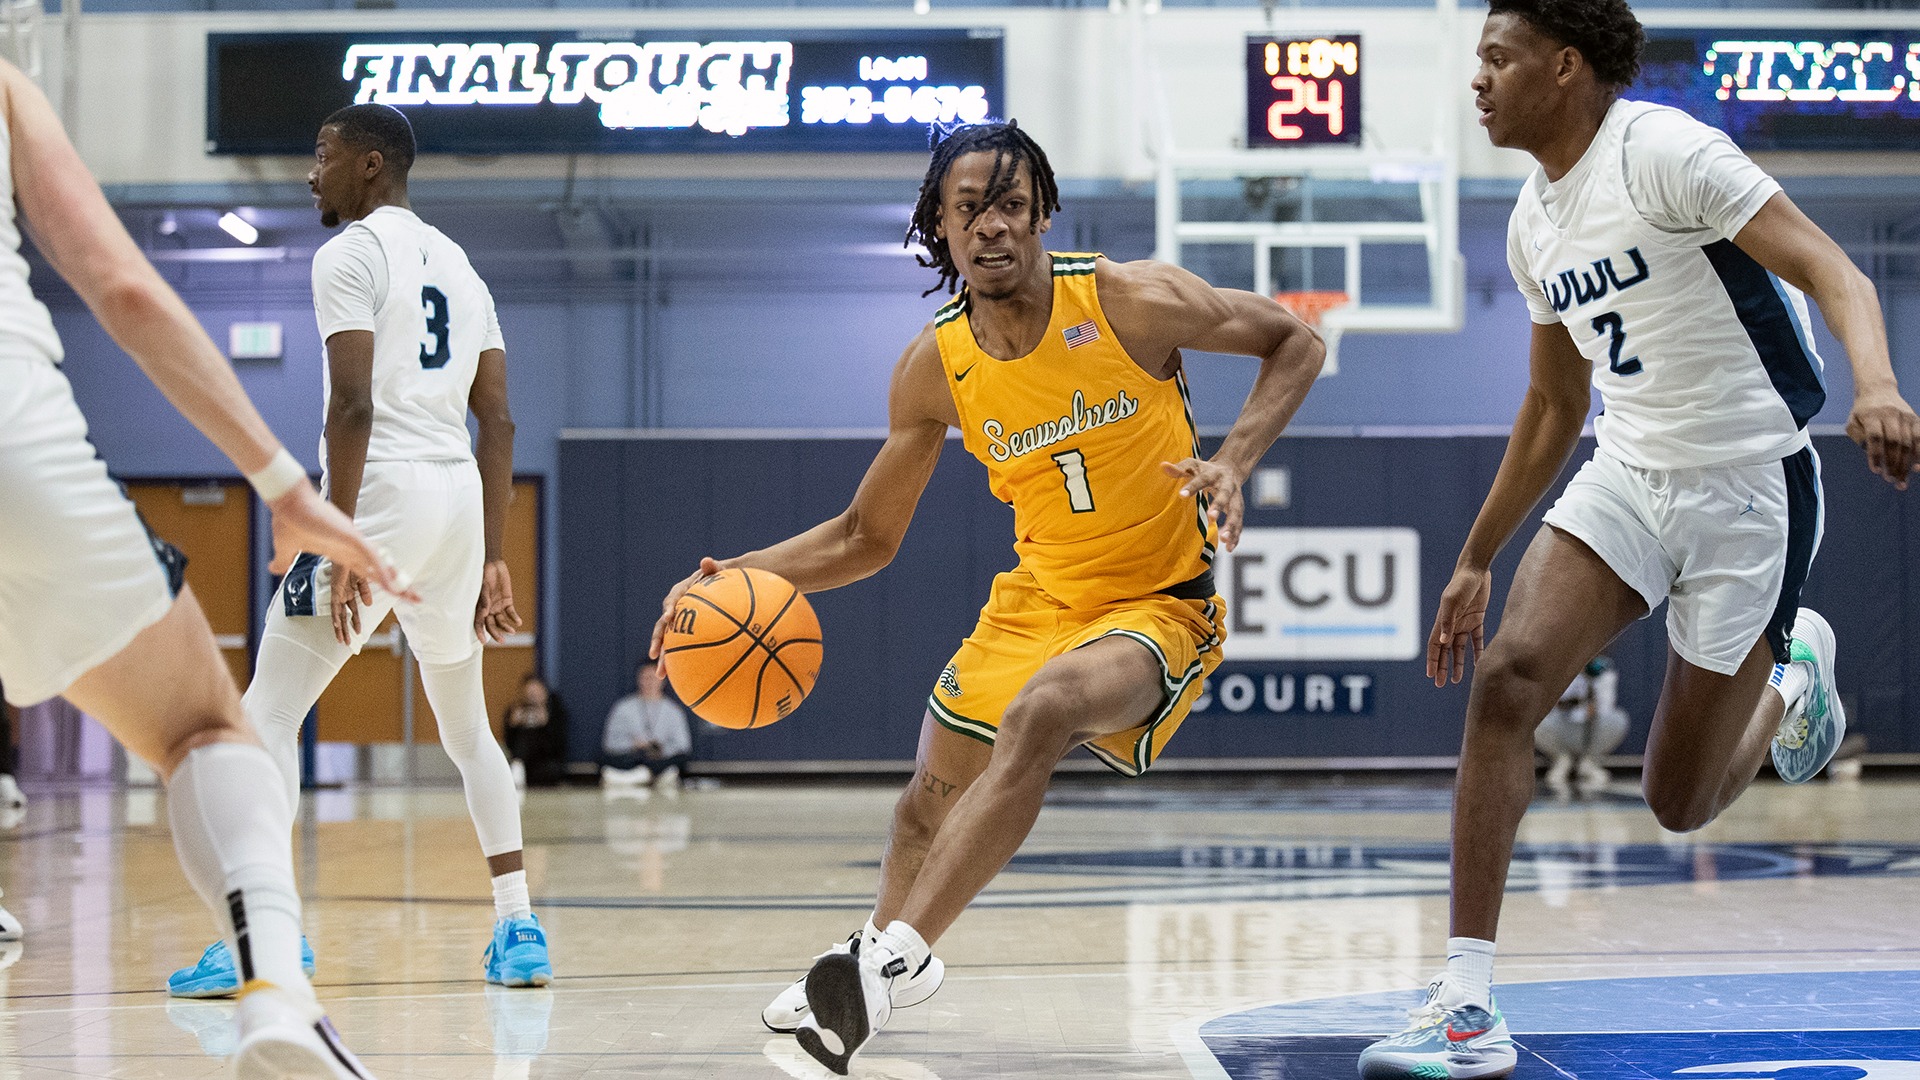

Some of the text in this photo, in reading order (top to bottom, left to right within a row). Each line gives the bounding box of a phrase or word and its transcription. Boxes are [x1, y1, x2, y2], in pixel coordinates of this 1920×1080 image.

[343, 43, 549, 104] FINAL
[549, 42, 793, 104] TOUCH
[1267, 75, 1343, 140] 24
[1540, 246, 1650, 313] WWU
[419, 285, 451, 370] 3
[1591, 311, 1645, 377] 2
[983, 389, 1138, 462] Seawolves
[1050, 447, 1096, 514] 1
[1212, 552, 1397, 634] ECU
